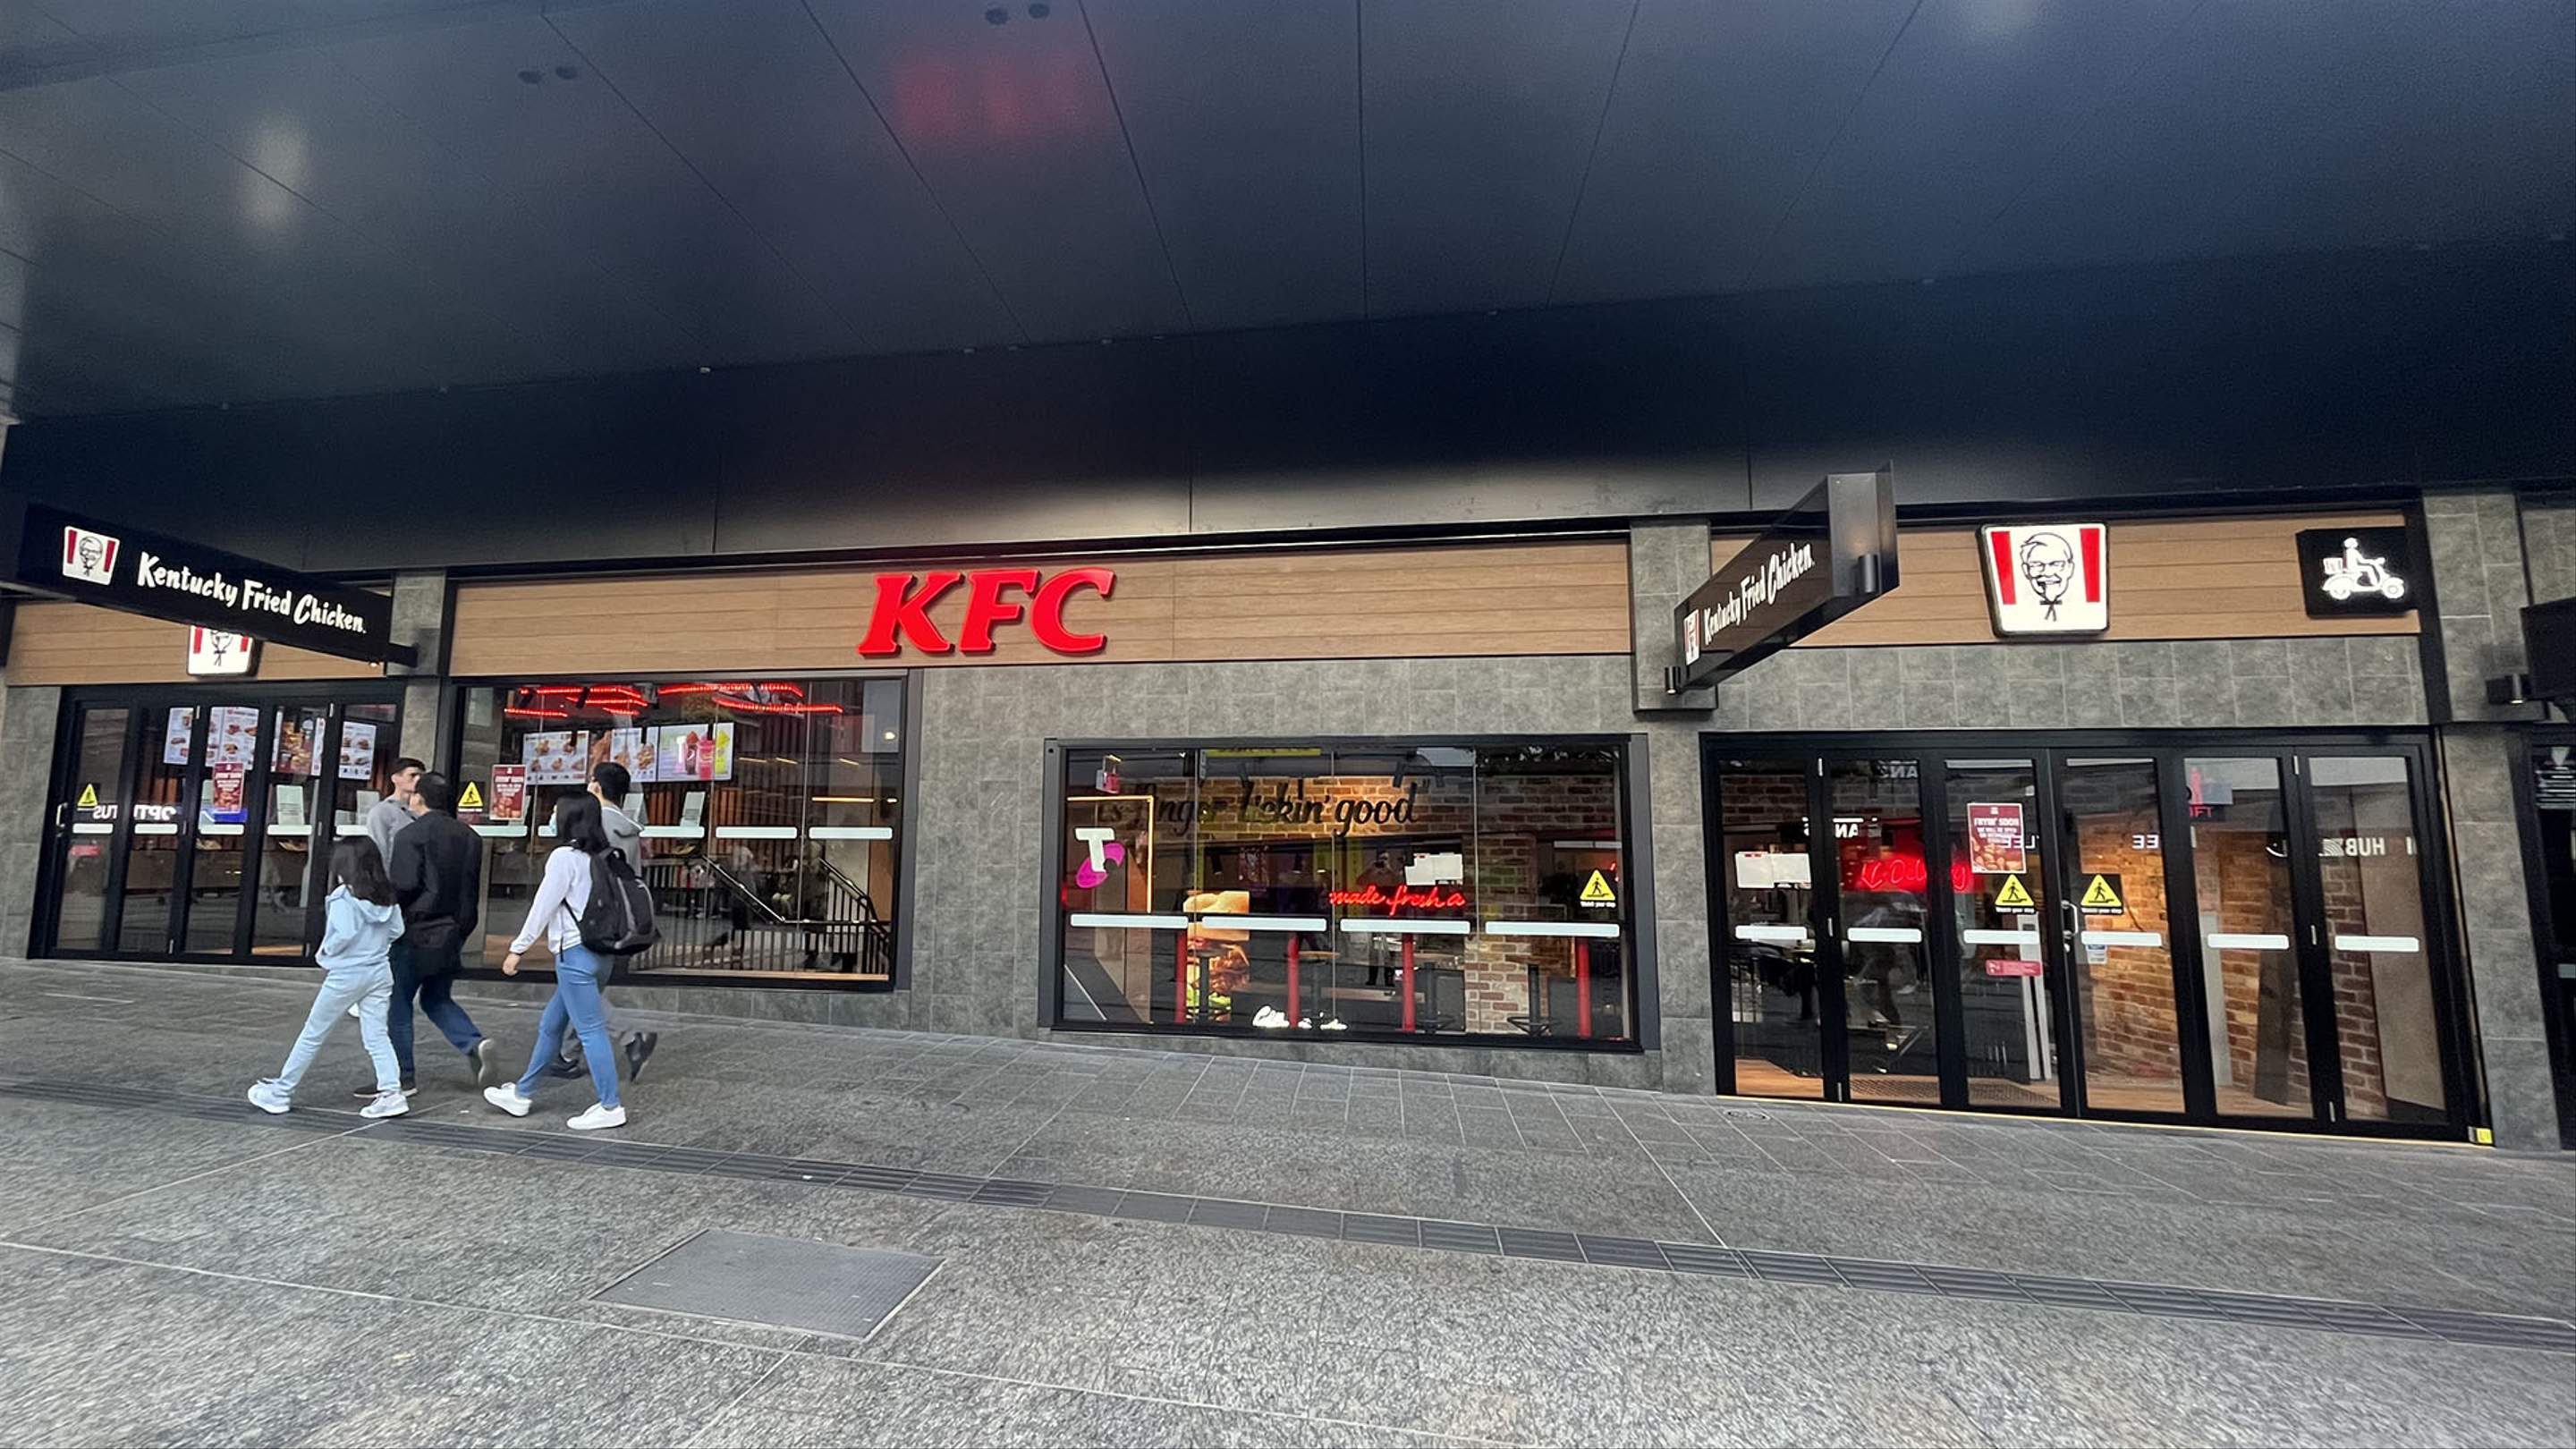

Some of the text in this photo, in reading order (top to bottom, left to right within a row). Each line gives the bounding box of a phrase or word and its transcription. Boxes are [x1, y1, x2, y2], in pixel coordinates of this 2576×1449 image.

[137, 551, 238, 607] Kentucky
[242, 579, 291, 615] Fried
[857, 566, 1116, 656] KFC
[1704, 591, 1741, 645] Kentucky
[1741, 565, 1767, 620] Fried
[1332, 782, 1418, 836] good
[1329, 886, 1385, 905] made
[1386, 885, 1445, 917] fresh
